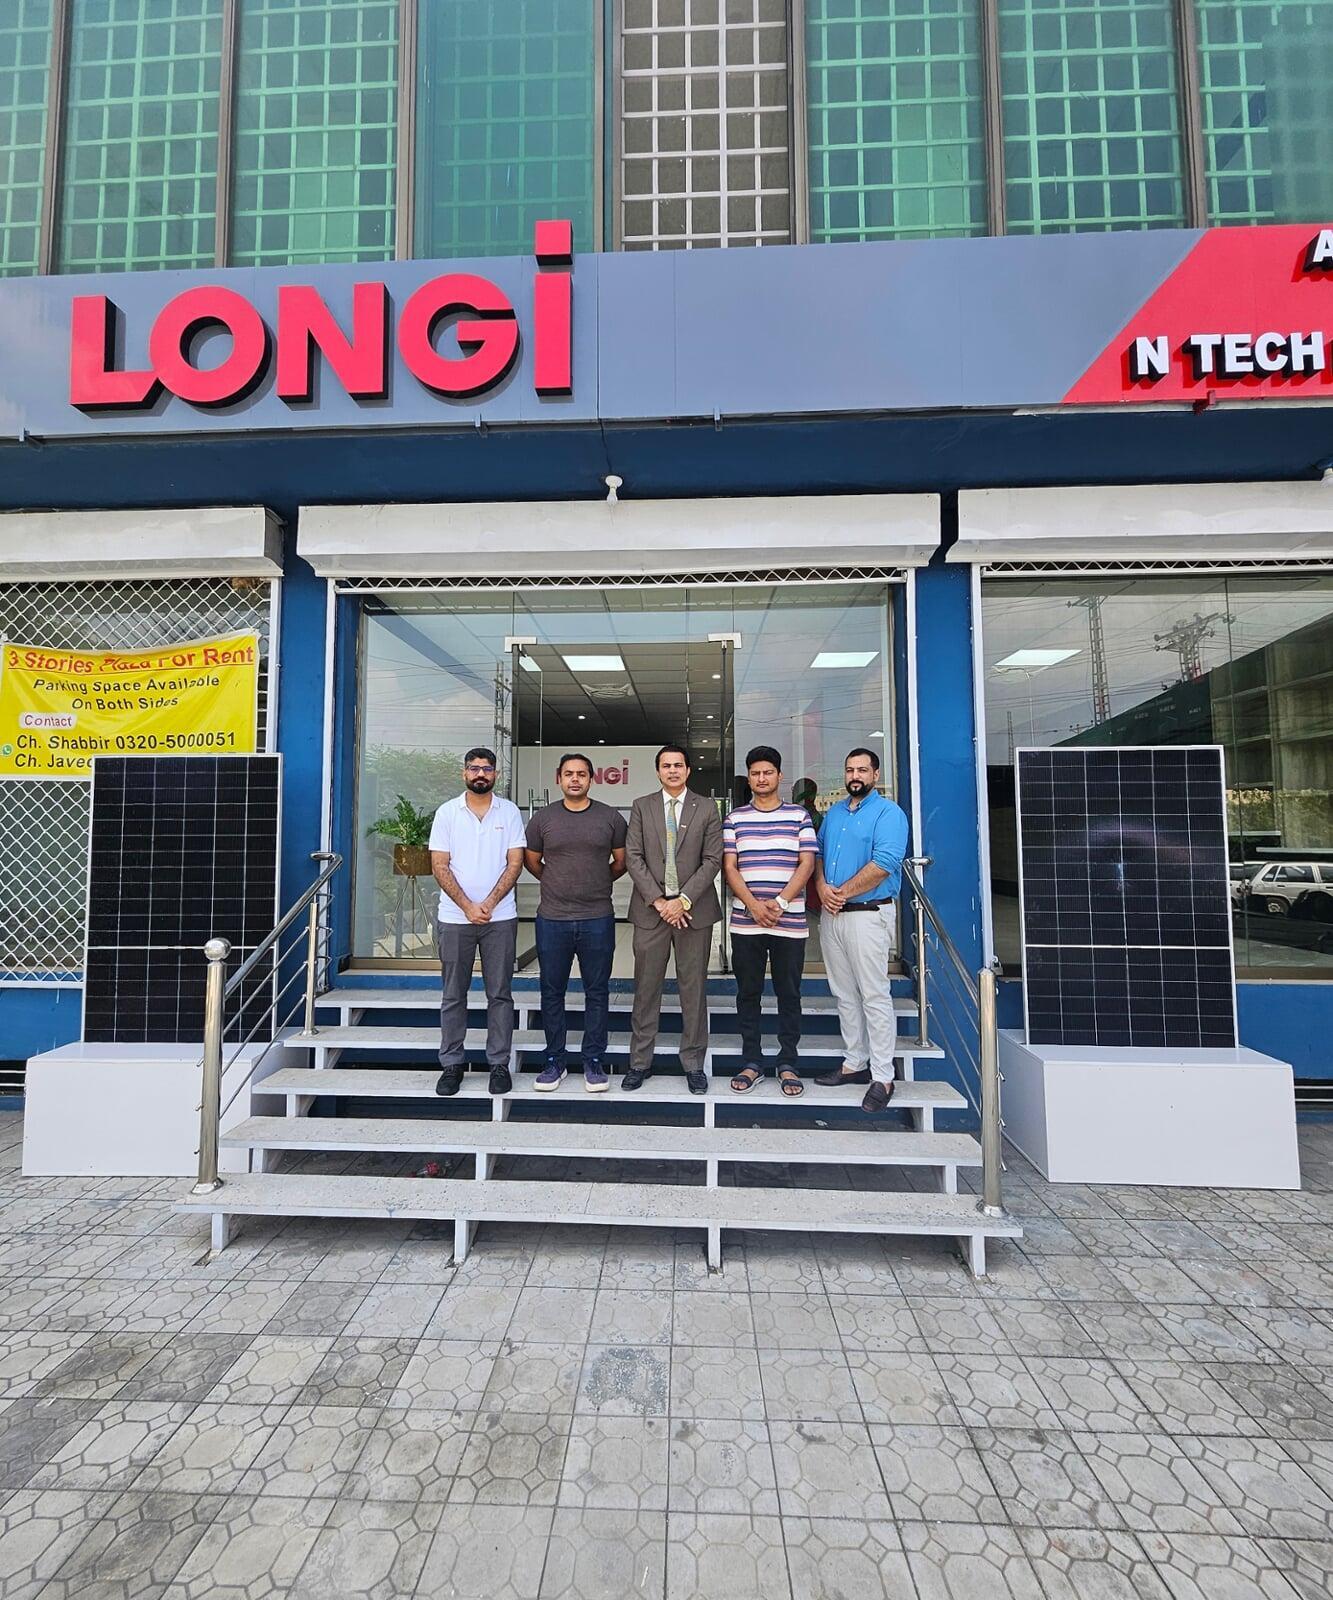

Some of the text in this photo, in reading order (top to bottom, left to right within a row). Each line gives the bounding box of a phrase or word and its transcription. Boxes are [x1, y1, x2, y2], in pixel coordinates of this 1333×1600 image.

[1135, 331, 1325, 375] N TECH
[8, 650, 19, 667] 3
[25, 652, 94, 673] Stories
[203, 646, 254, 666] Rent
[33, 675, 220, 694] Parking Space Available
[72, 697, 178, 711] On Both Sides
[24, 714, 72, 727] Contact
[16, 732, 235, 749] Ch. Shabbir 0320-5000051
[14, 753, 42, 768] Ch.
